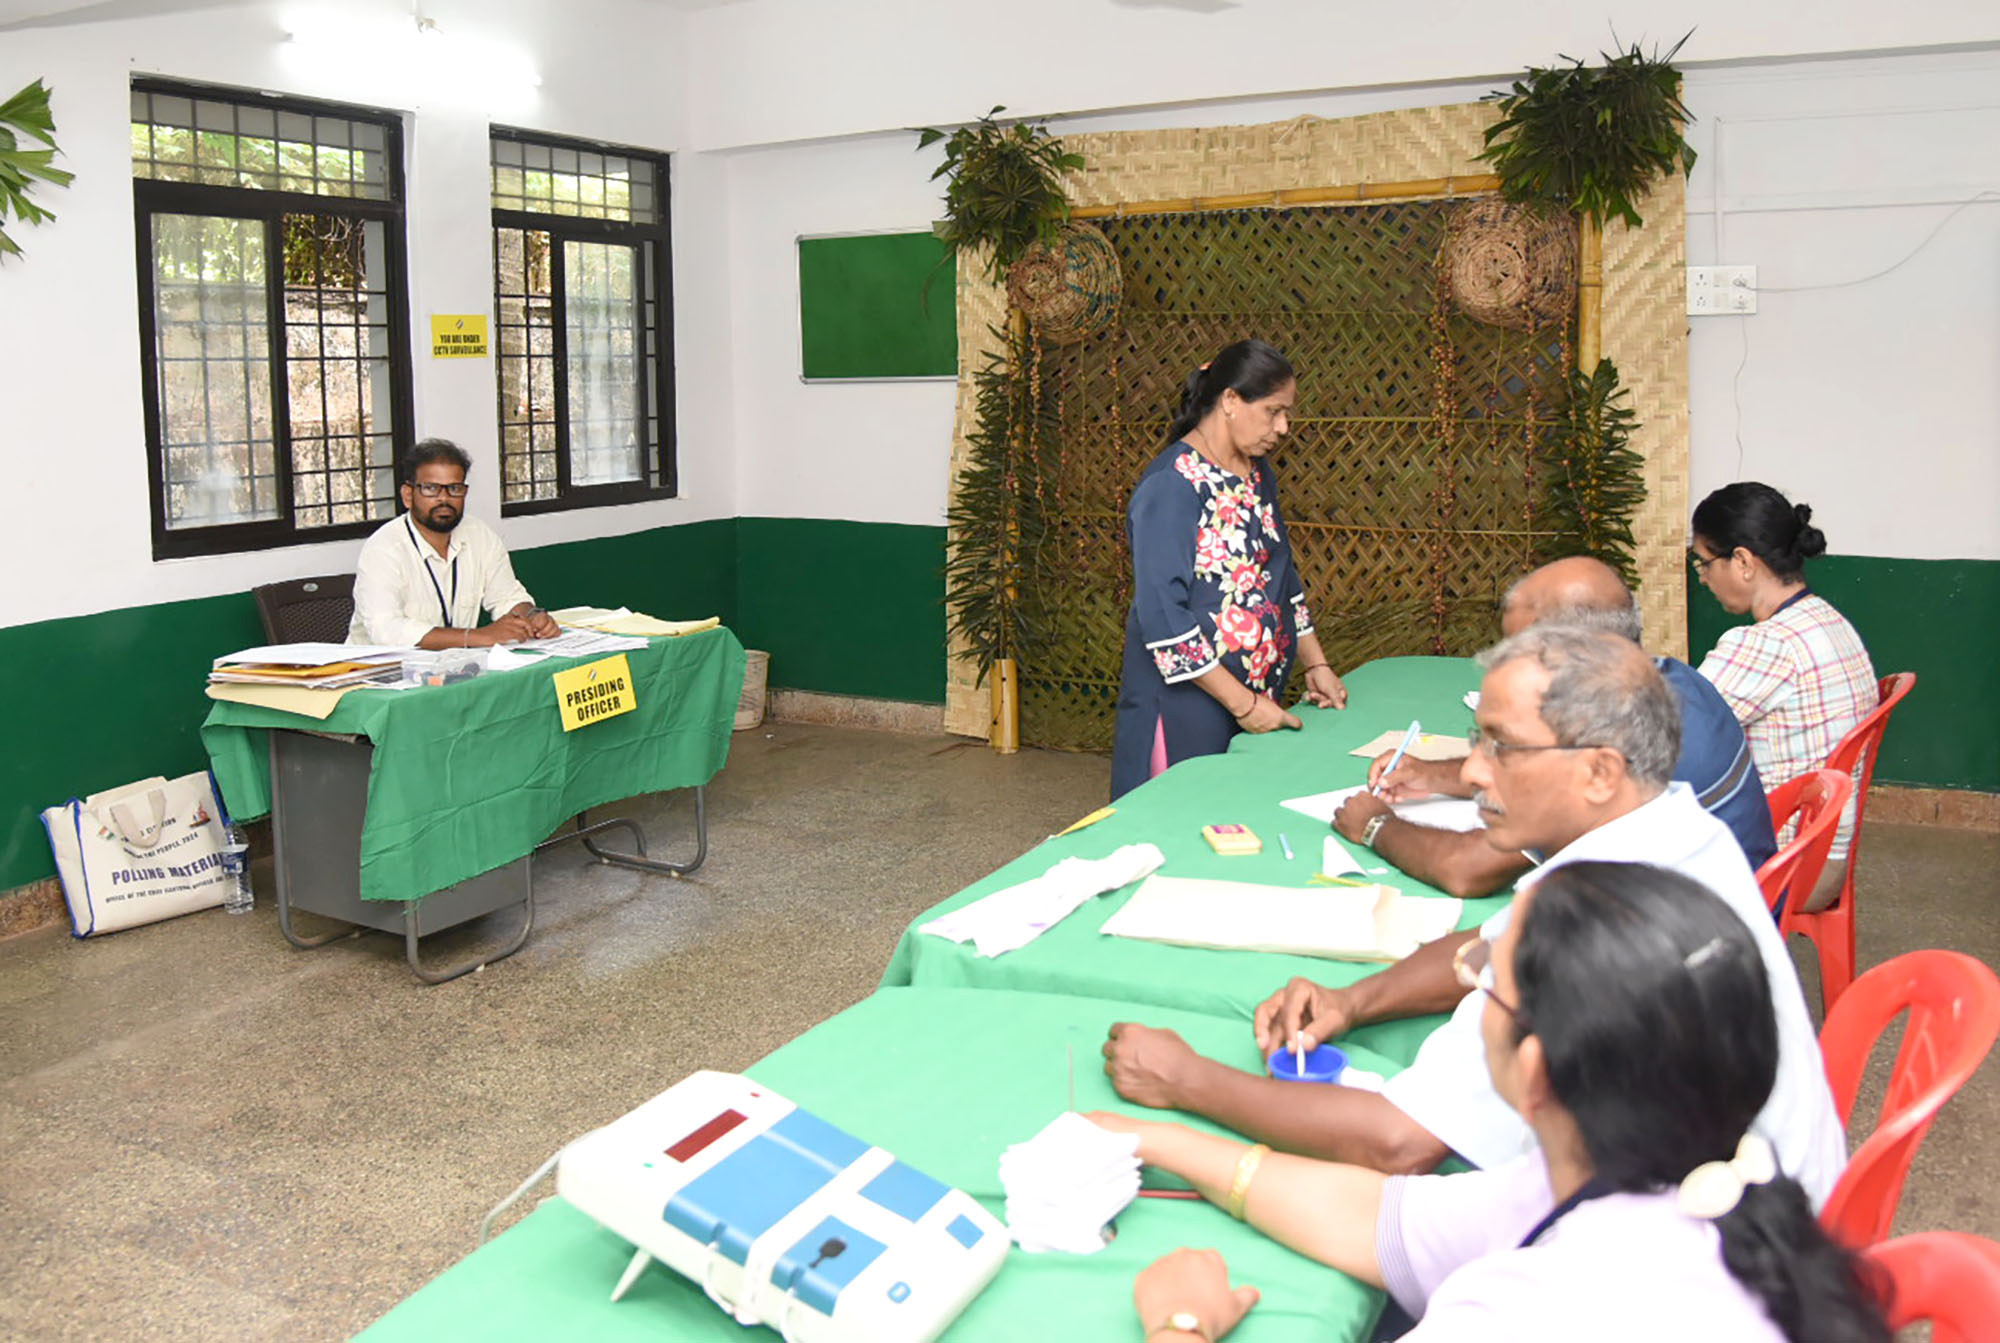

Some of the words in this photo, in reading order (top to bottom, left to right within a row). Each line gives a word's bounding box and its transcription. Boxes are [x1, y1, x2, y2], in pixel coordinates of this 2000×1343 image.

[440, 334, 451, 344] YOU
[452, 334, 462, 344] ARE
[463, 334, 480, 344] UNDER
[433, 345, 449, 356] CCTV
[566, 677, 625, 707] PRESIDING
[577, 696, 621, 721] OFFICER
[112, 867, 165, 885] POLLING
